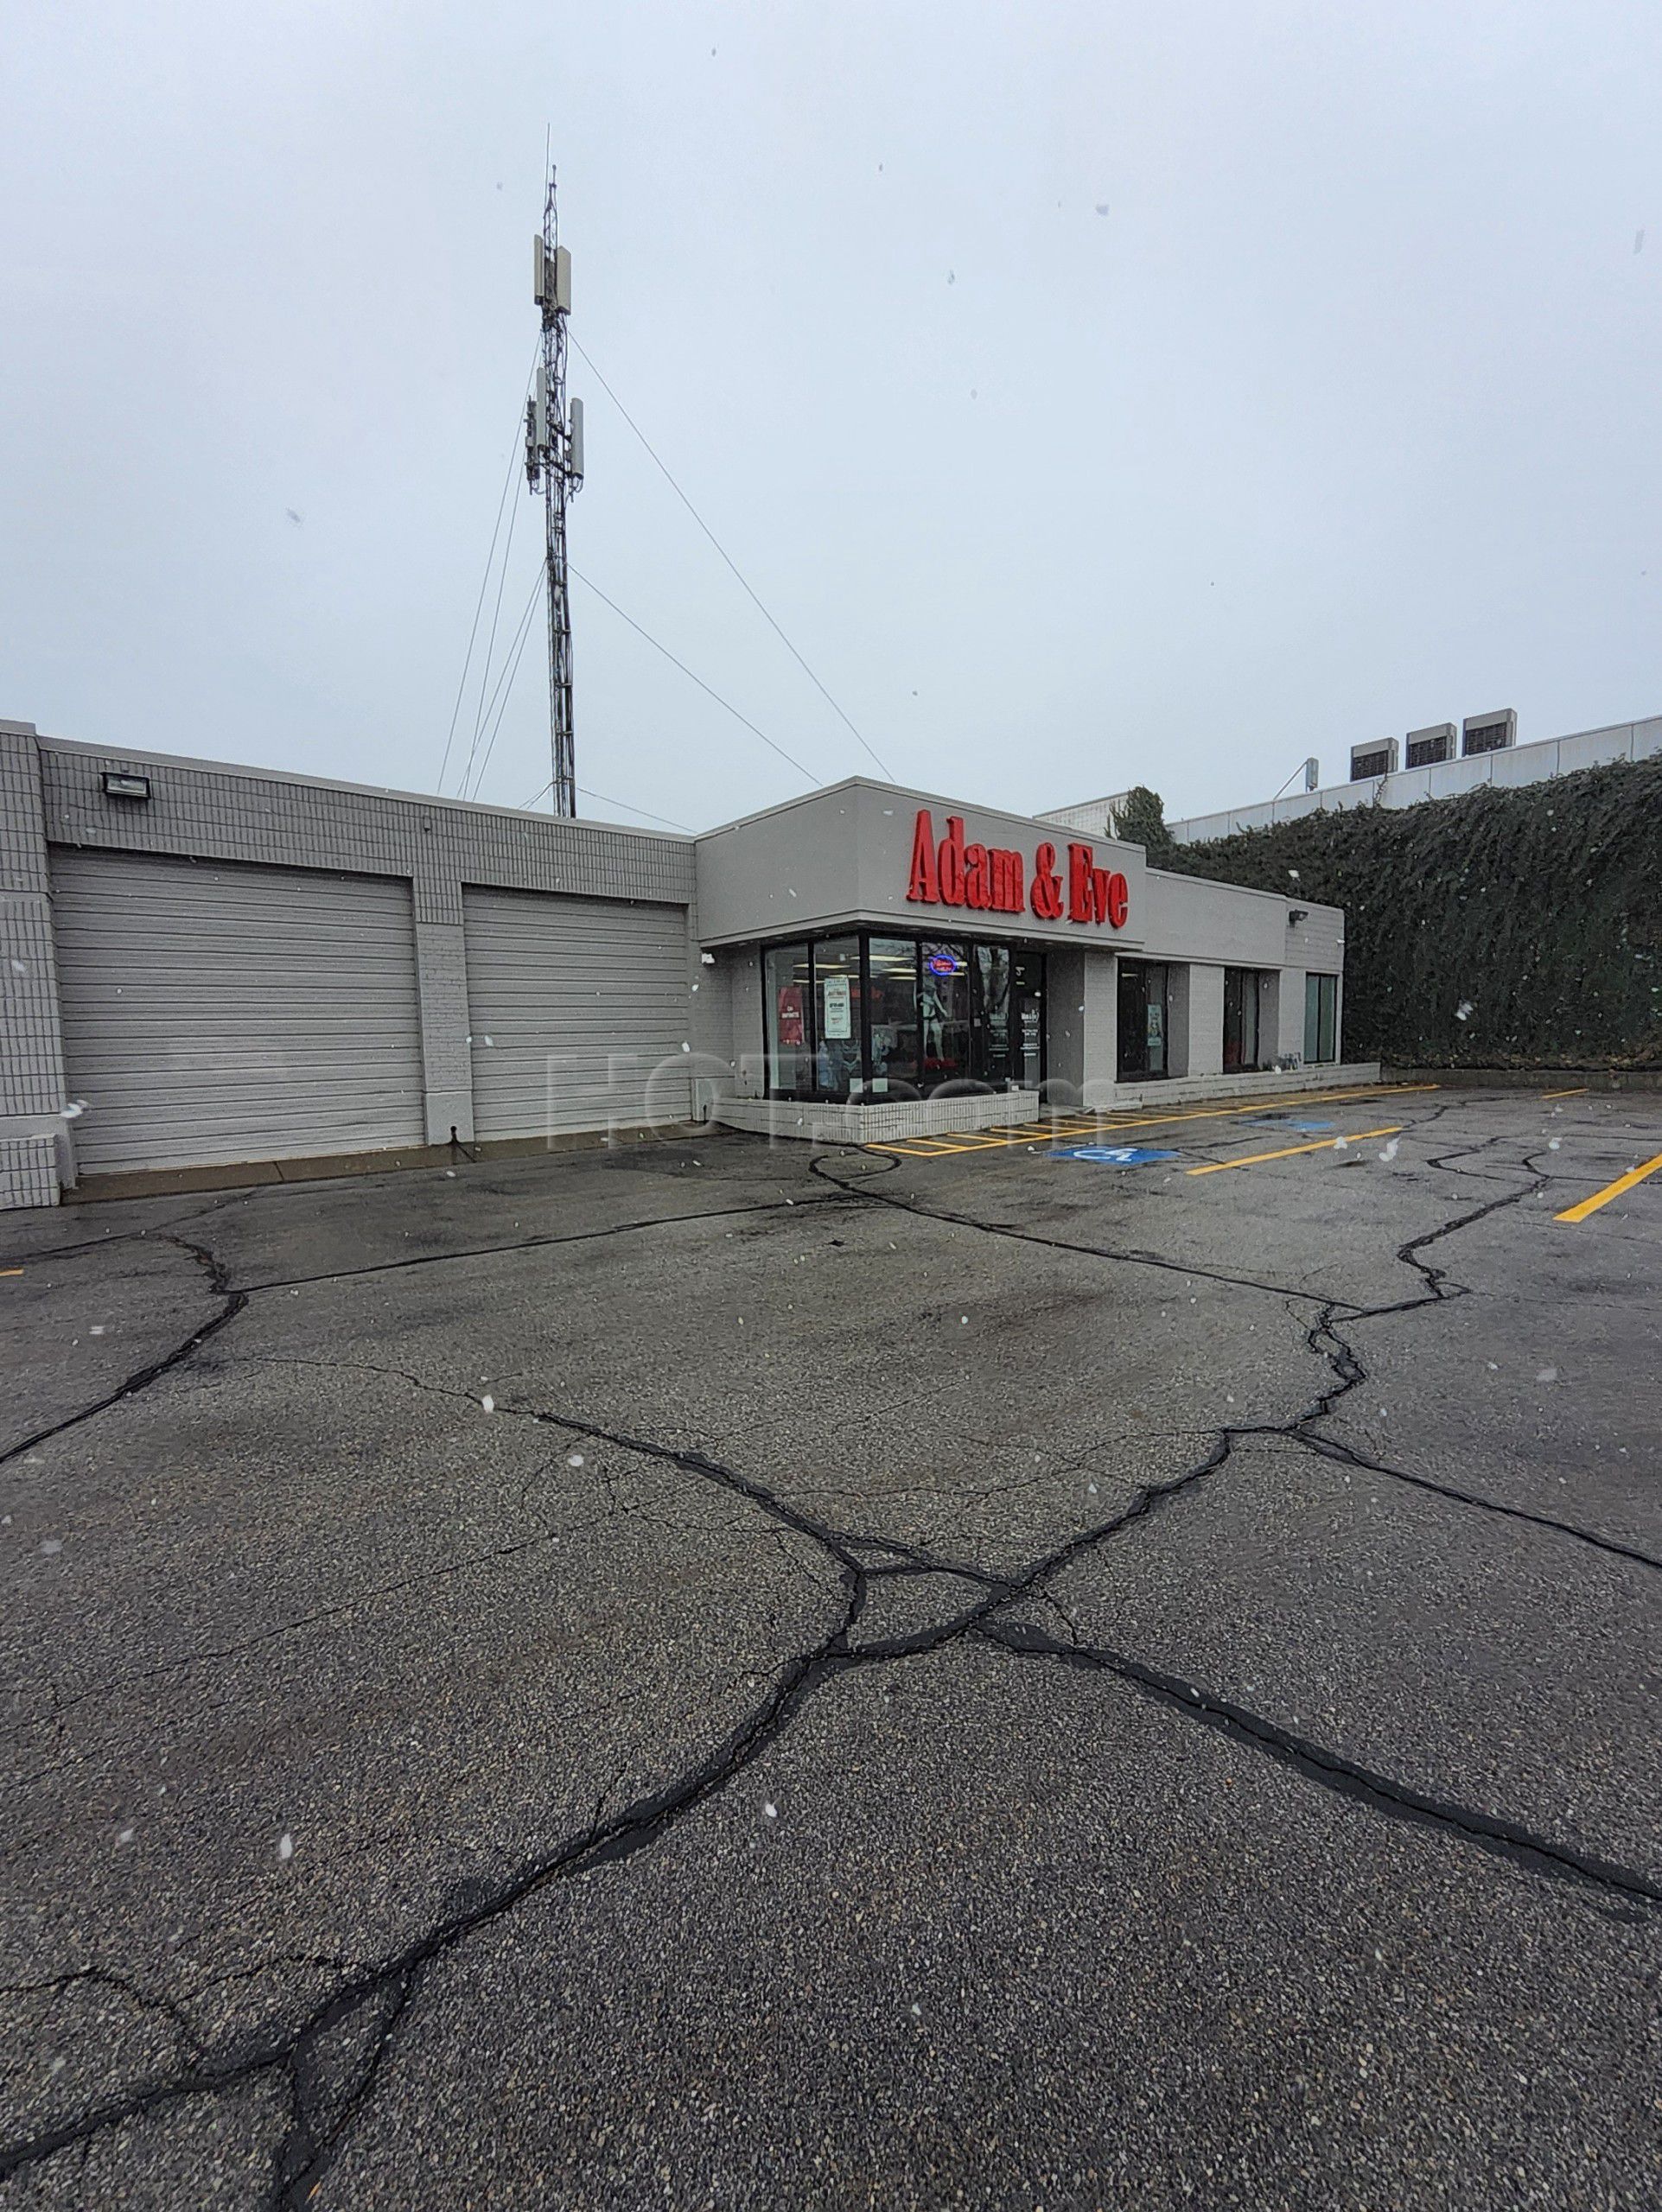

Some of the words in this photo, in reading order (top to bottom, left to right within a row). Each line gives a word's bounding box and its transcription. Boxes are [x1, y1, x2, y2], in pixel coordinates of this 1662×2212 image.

[906, 809, 1026, 913] Adam
[1030, 842, 1064, 919] &
[1067, 842, 1129, 929] Eve
